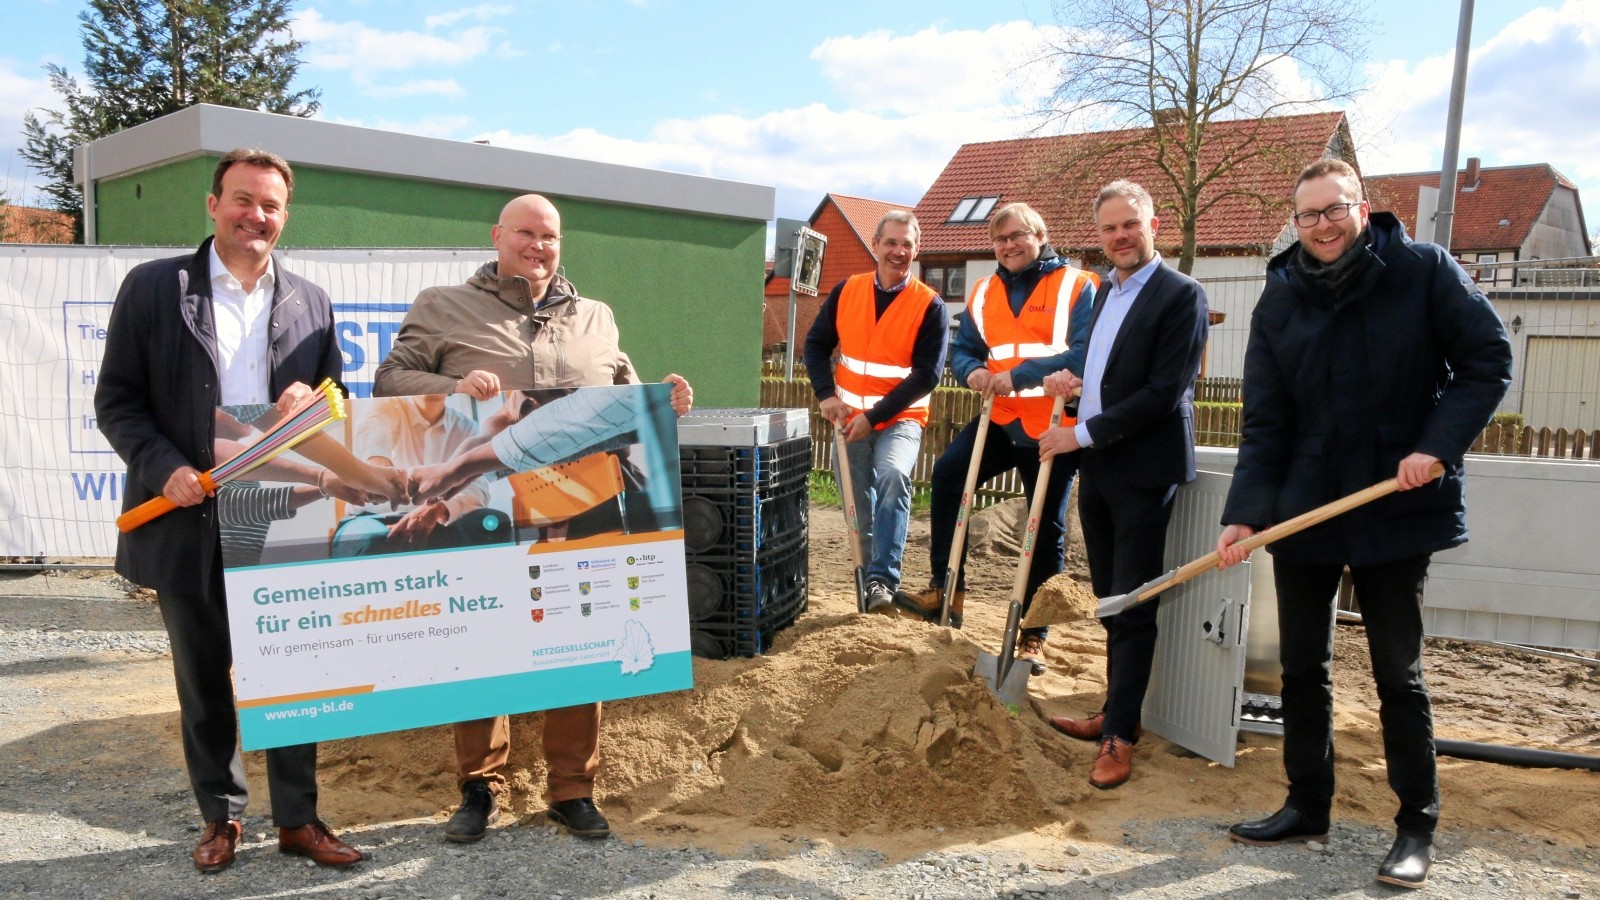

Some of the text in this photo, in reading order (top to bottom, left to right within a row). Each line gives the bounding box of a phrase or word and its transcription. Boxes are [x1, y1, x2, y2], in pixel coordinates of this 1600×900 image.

[253, 578, 387, 606] Gemeinsam
[395, 570, 449, 592] stark
[256, 594, 504, 634] für ein schnelles Netz.
[259, 644, 280, 656] Wir
[284, 637, 354, 656] gemeinsam
[366, 633, 383, 645] für
[386, 629, 425, 642] unsere
[428, 624, 468, 640] Region
[532, 640, 615, 656] NETZGESELLSCHAFT
[265, 700, 354, 721] www.ng-bl.de
